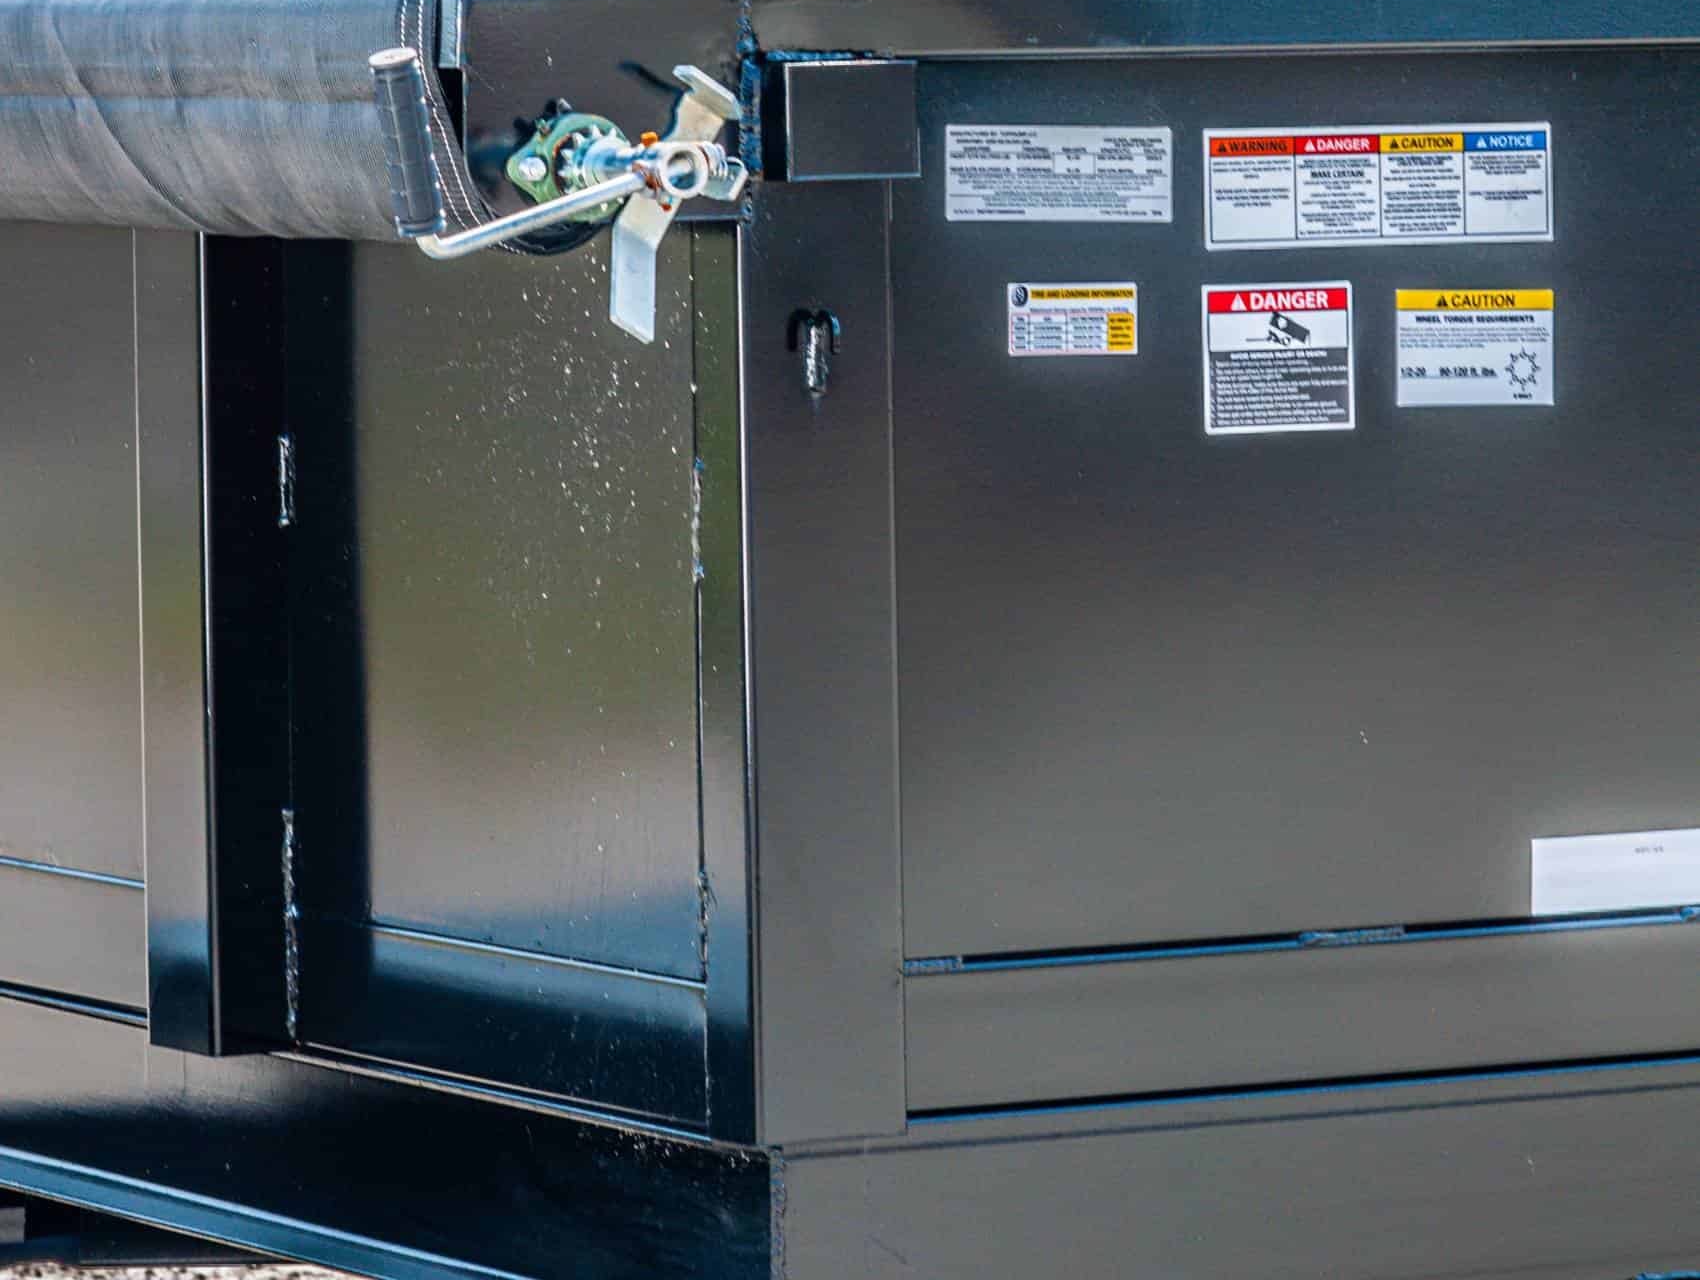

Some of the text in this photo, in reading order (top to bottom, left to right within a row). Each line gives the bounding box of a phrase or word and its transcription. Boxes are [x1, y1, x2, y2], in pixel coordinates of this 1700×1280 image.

[1229, 140, 1288, 153] WARNING
[1317, 137, 1371, 152] DANGER
[1401, 135, 1454, 149] CAUTION
[1489, 134, 1534, 148] NOTICE
[1250, 291, 1329, 310] DANGER
[1451, 294, 1516, 308] CAUTION
[1415, 315, 1535, 324] WHEEL TORQUE REQUIREMENTS
